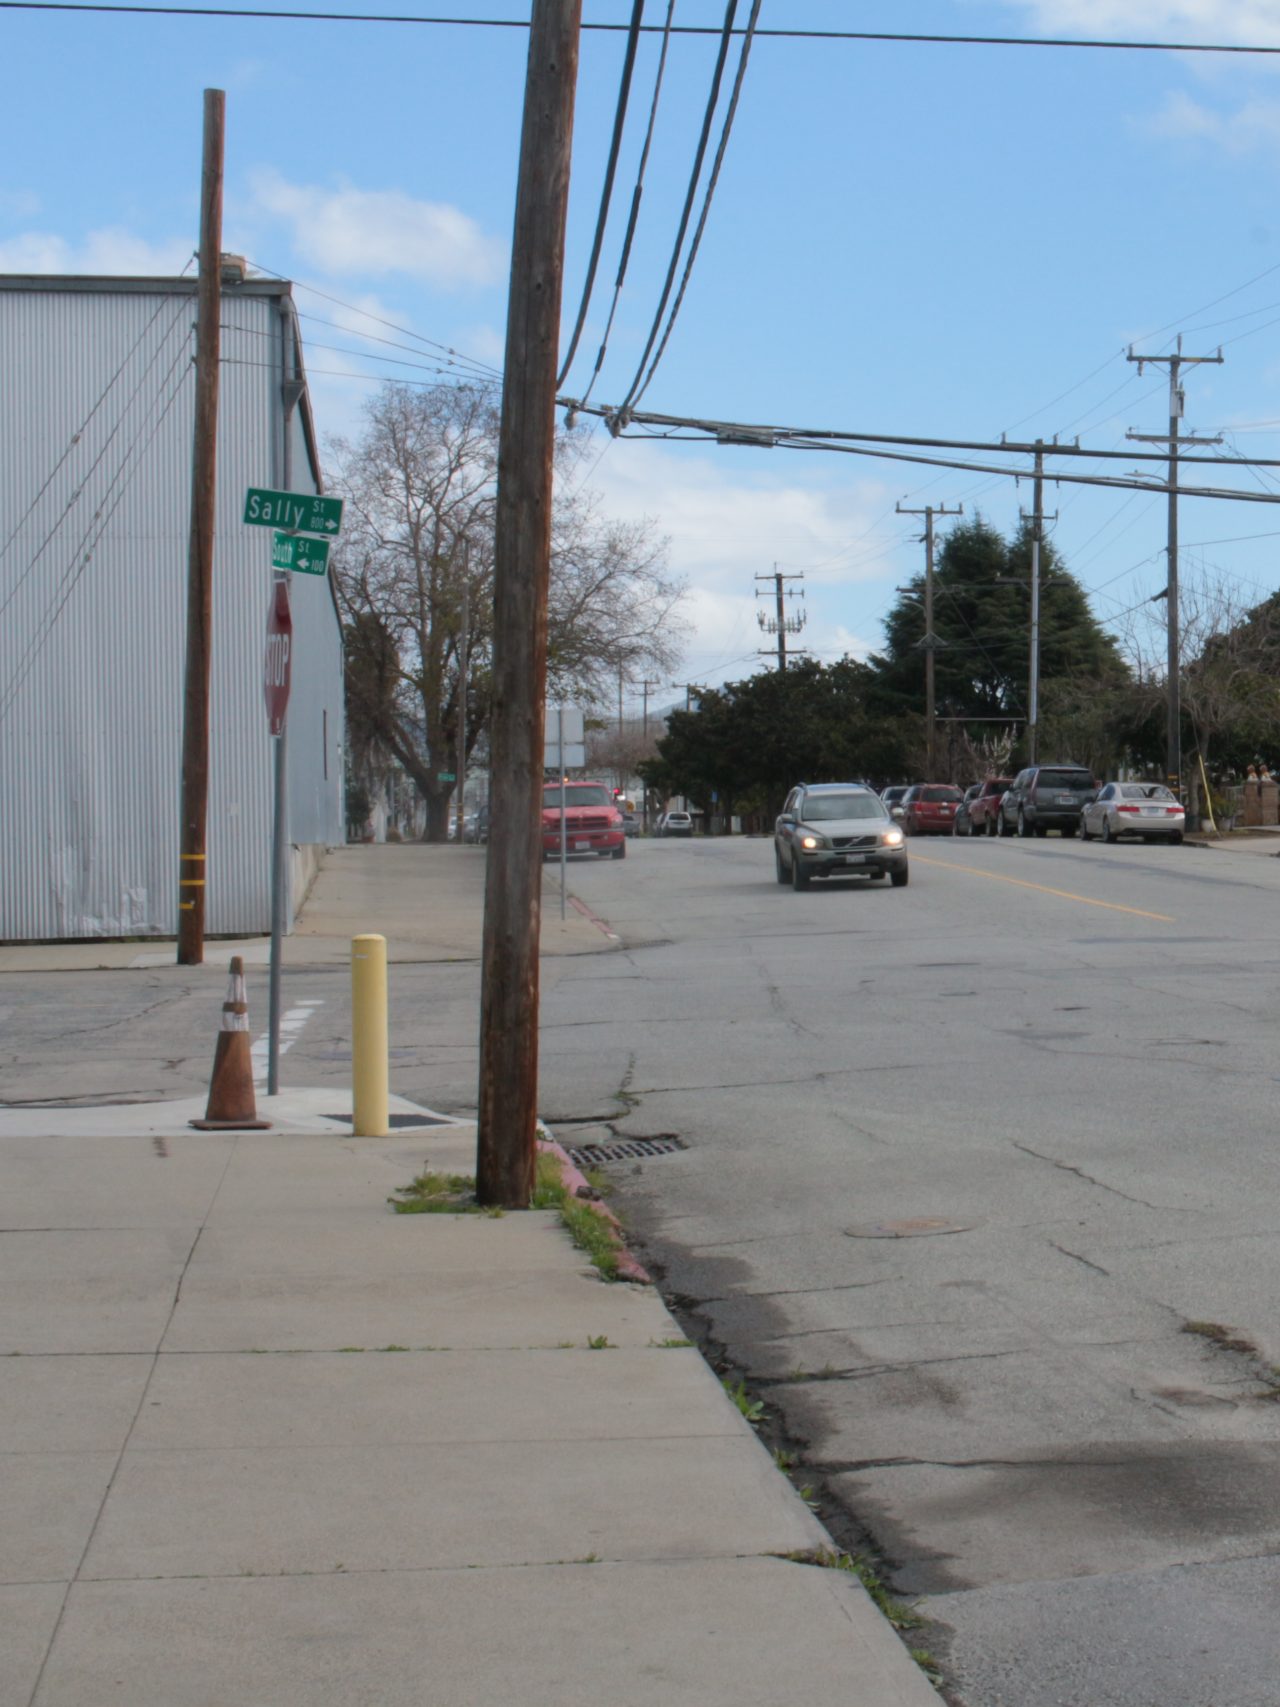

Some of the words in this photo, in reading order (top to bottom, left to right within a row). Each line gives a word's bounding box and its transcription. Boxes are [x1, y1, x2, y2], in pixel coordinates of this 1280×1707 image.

[249, 495, 305, 529] Sally
[313, 500, 325, 513] St
[310, 516, 324, 529] 800
[272, 537, 293, 564] South
[298, 541, 310, 553] St
[311, 560, 325, 572] 100
[266, 633, 289, 687] STOP
